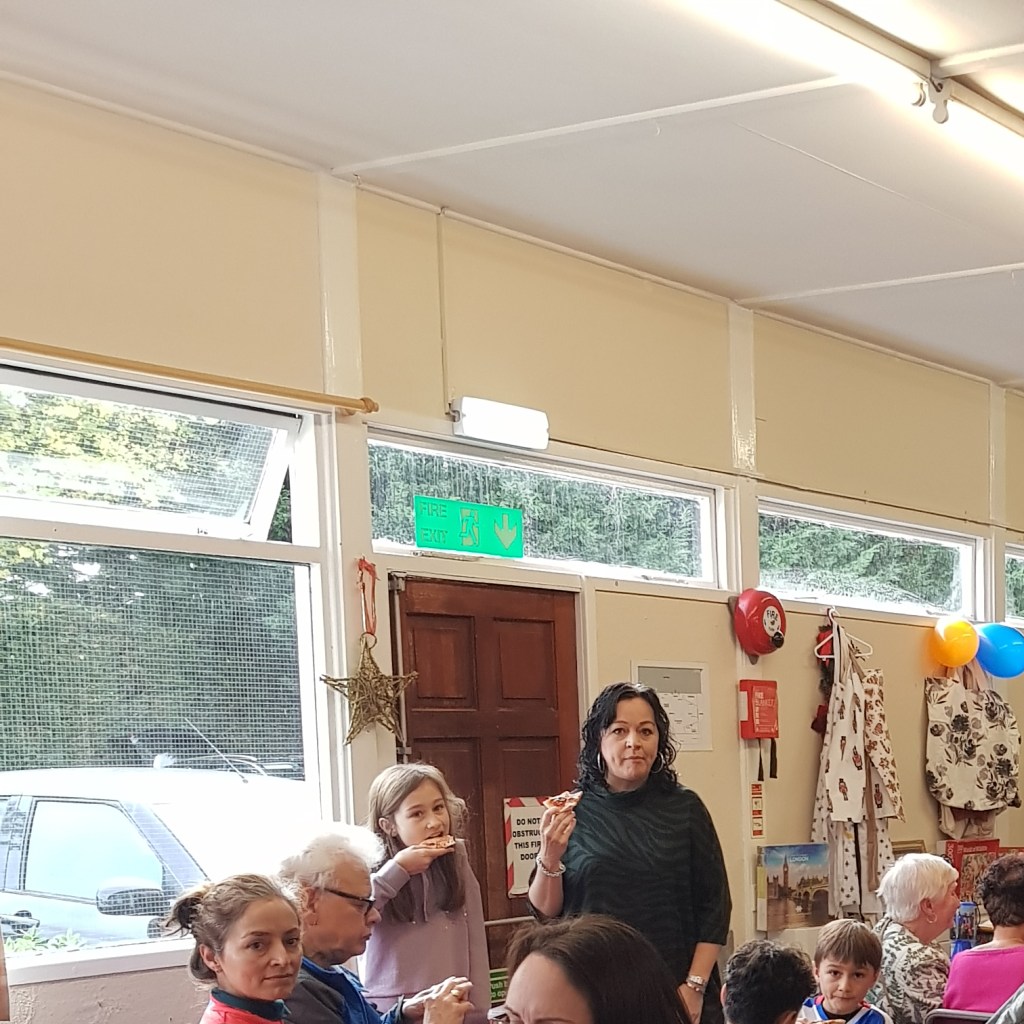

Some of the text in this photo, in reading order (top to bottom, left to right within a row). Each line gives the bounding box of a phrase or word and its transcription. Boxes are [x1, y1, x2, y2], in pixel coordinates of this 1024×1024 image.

[420, 502, 447, 518] FIRE
[421, 528, 448, 544] EXIT
[516, 817, 541, 826] DO NOT
[512, 830, 541, 838] OBSTRU
[514, 842, 529, 850] THIS
[789, 855, 809, 863] LONDON
